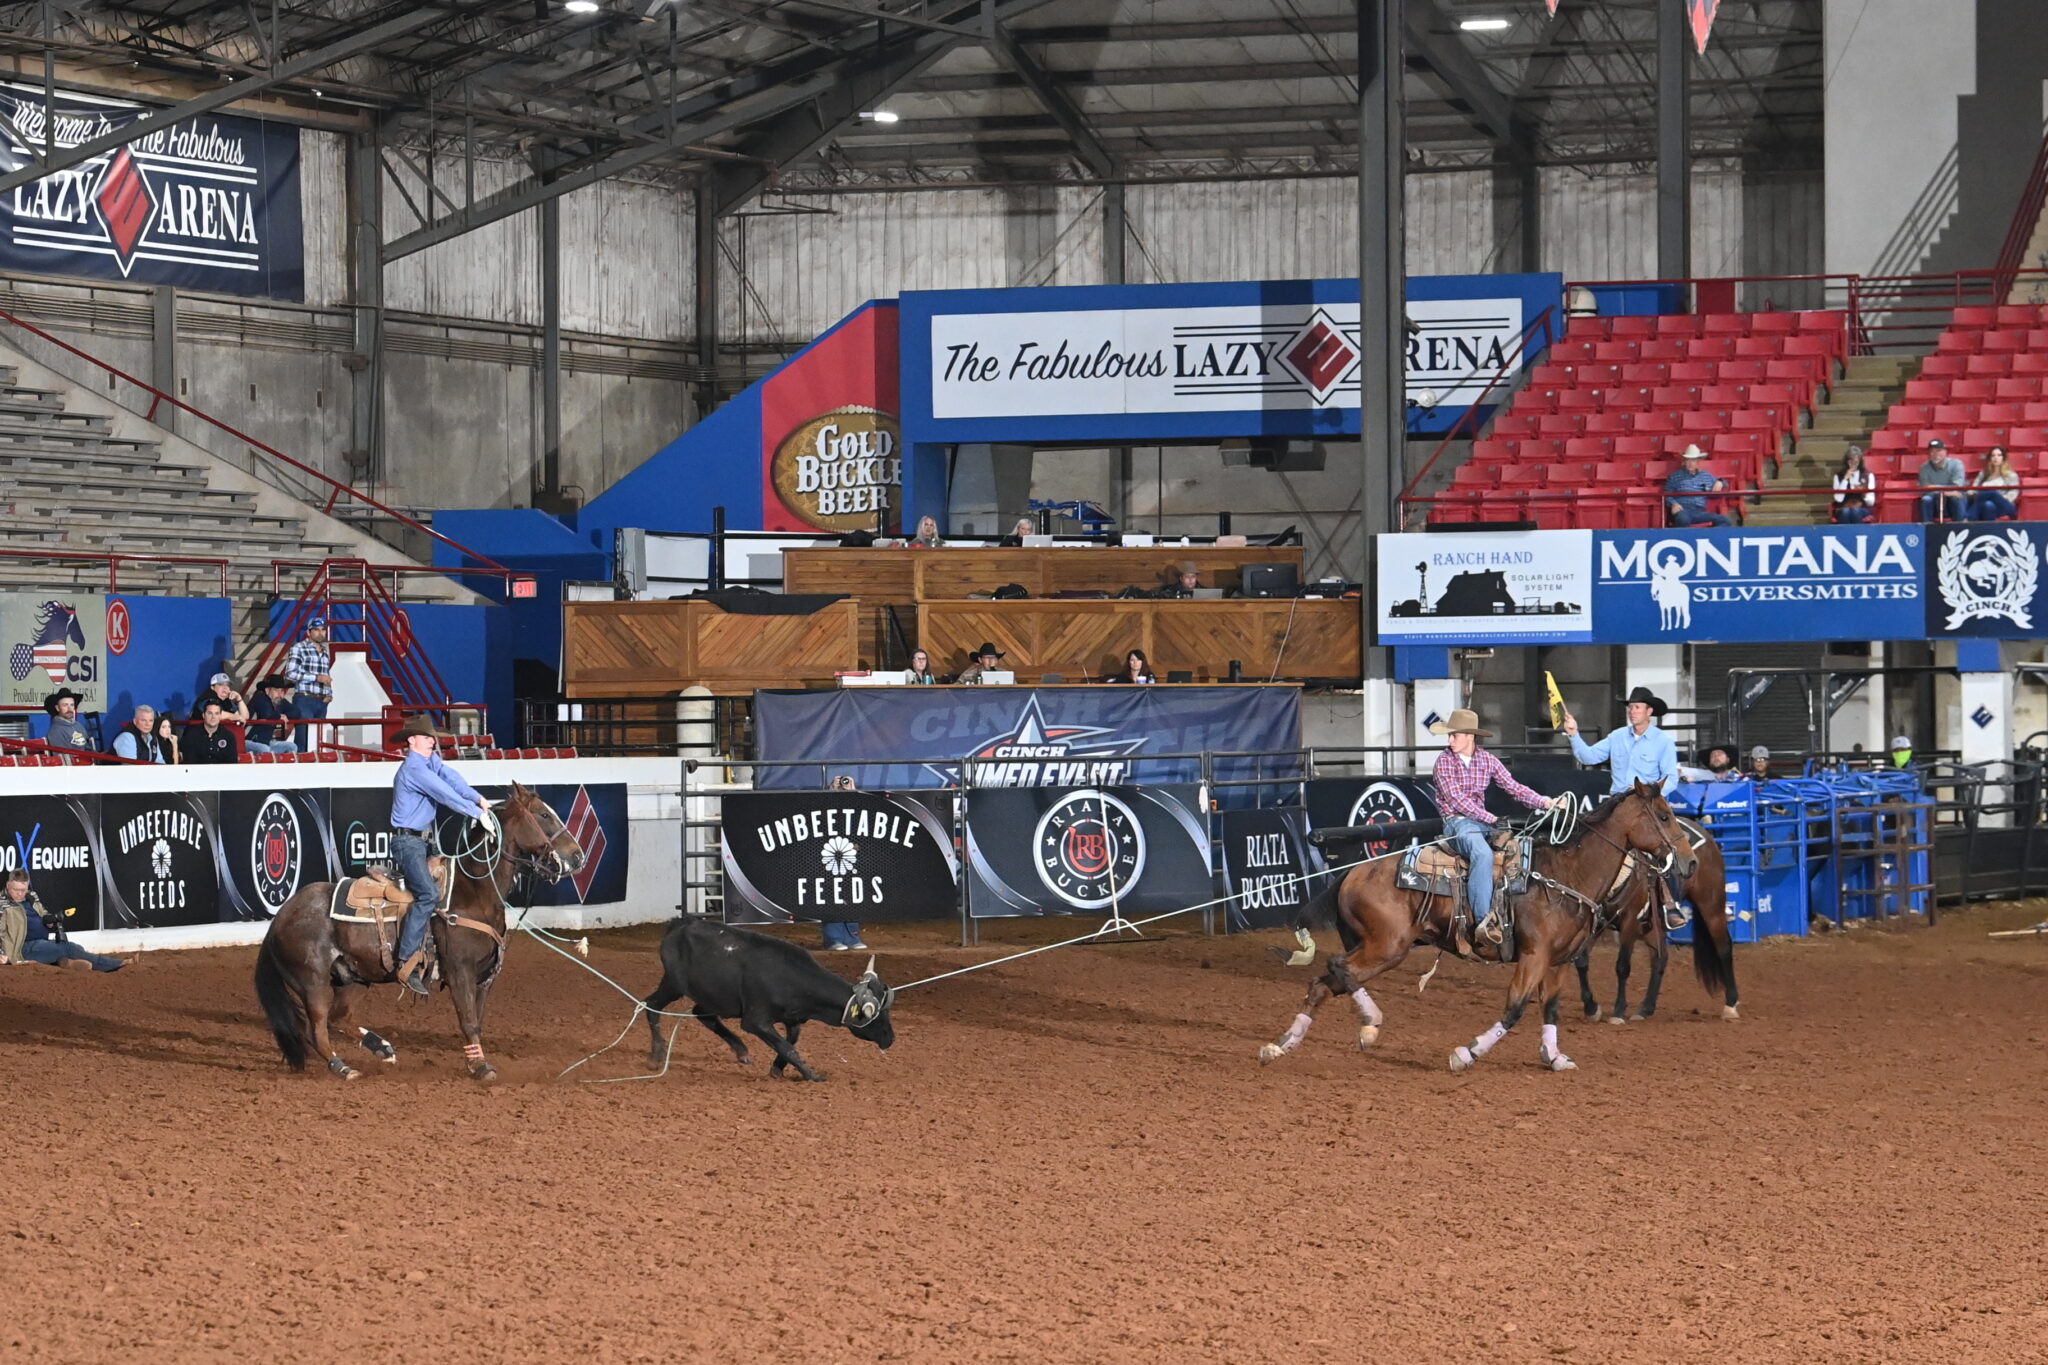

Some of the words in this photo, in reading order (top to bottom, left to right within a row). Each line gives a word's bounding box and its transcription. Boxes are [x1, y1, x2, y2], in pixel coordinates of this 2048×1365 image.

[168, 117, 244, 164] Fabulous
[13, 162, 93, 224] LAZY
[158, 181, 258, 244] ARENA
[944, 341, 1000, 382] The
[1009, 339, 1167, 380] Fabulous
[1173, 341, 1278, 378] LAZY
[1405, 335, 1509, 372] RENA
[817, 486, 890, 515] BEER
[1433, 553, 1485, 566] RANCH
[1490, 551, 1533, 564] HAND
[1600, 535, 1916, 579] MONTANA
[1545, 573, 1575, 581] LIGHT
[1693, 583, 1918, 602] SILVERSMITHS
[1966, 601, 2011, 613] CINCH
[112, 612, 124, 638] K
[67, 655, 97, 682] CSI
[995, 746, 1066, 758] CINCH
[259, 804, 293, 831] RIATA
[1358, 792, 1404, 818] RIATA
[119, 810, 203, 854] UNBEETABLE
[757, 808, 920, 852] UNBEETABLE
[32, 846, 89, 871] EQUINE
[351, 832, 393, 859] GLO
[1246, 833, 1290, 868] RIATA
[139, 880, 186, 910] FEEDS
[256, 861, 297, 903] BUCKLE
[798, 876, 883, 905] FEEDS
[1241, 873, 1299, 910] BUCKLE
